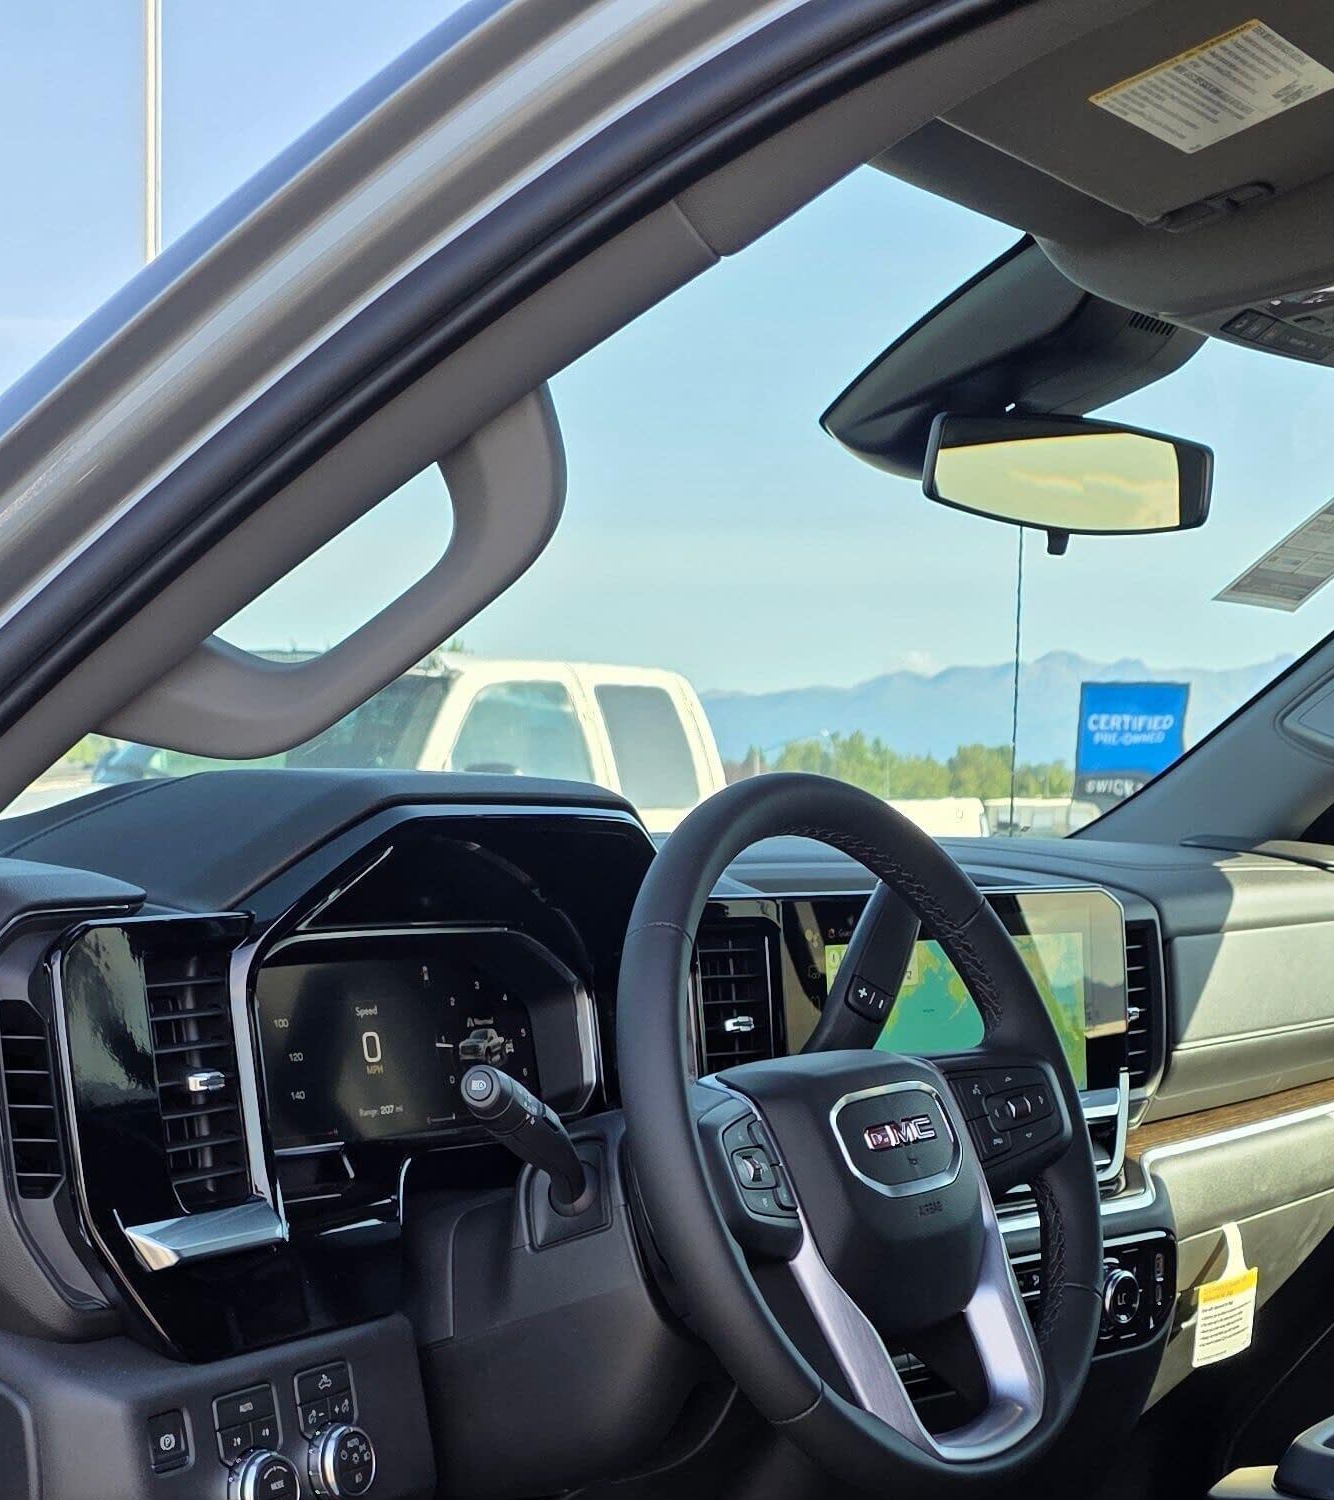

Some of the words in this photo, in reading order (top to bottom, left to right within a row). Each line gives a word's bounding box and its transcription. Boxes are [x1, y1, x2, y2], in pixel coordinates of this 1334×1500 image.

[1088, 713, 1174, 731] CERTIFIED
[1093, 731, 1165, 746] PRE-OWNED
[355, 1005, 378, 1019] Speed
[273, 1018, 290, 1029] 100
[362, 1031, 382, 1063] 0
[288, 1052, 304, 1062] 120
[367, 1064, 384, 1075] MPH
[290, 1090, 306, 1100] 140
[380, 1104, 395, 1115] 207
